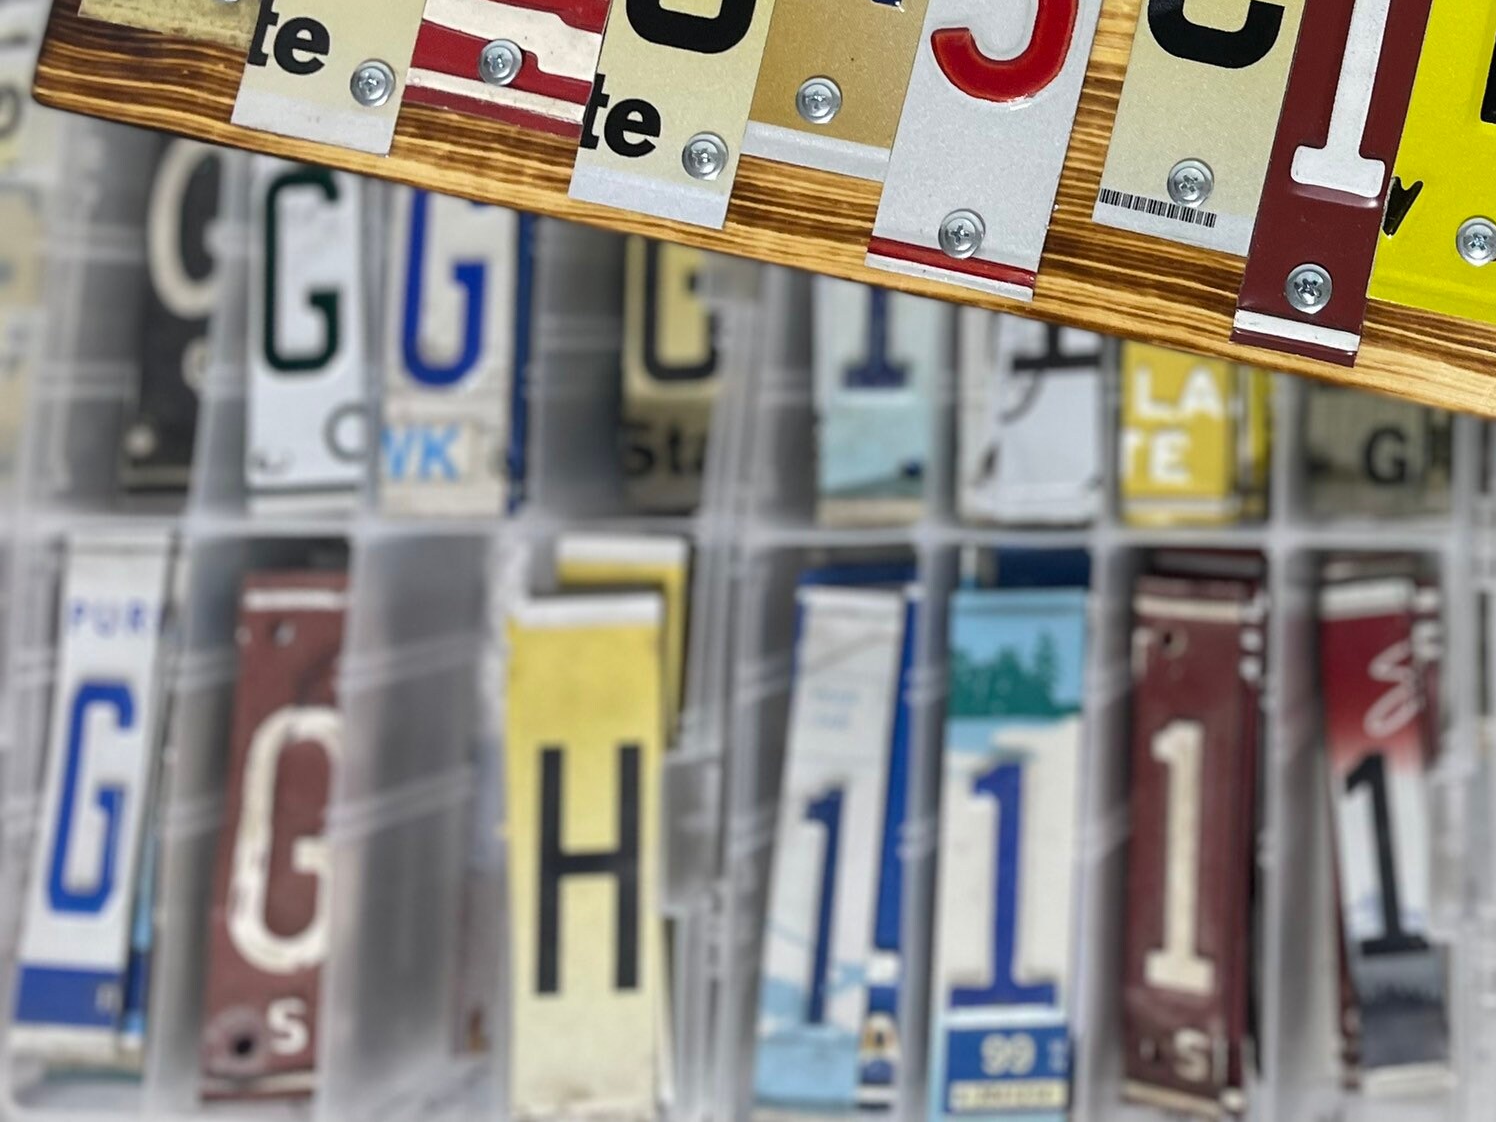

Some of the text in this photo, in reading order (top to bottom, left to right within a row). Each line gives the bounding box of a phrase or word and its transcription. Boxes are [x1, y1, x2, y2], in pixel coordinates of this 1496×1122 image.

[264, 168, 341, 370] G
[402, 190, 488, 386] G
[1361, 429, 1406, 487] G
[47, 678, 136, 915] G
[228, 704, 343, 974] G
[534, 738, 644, 996] H
[948, 758, 1060, 1010] 1
[1143, 718, 1216, 995] 1
[1344, 750, 1432, 956] 1
[265, 995, 308, 1058] S
[980, 1031, 1036, 1077] 99
